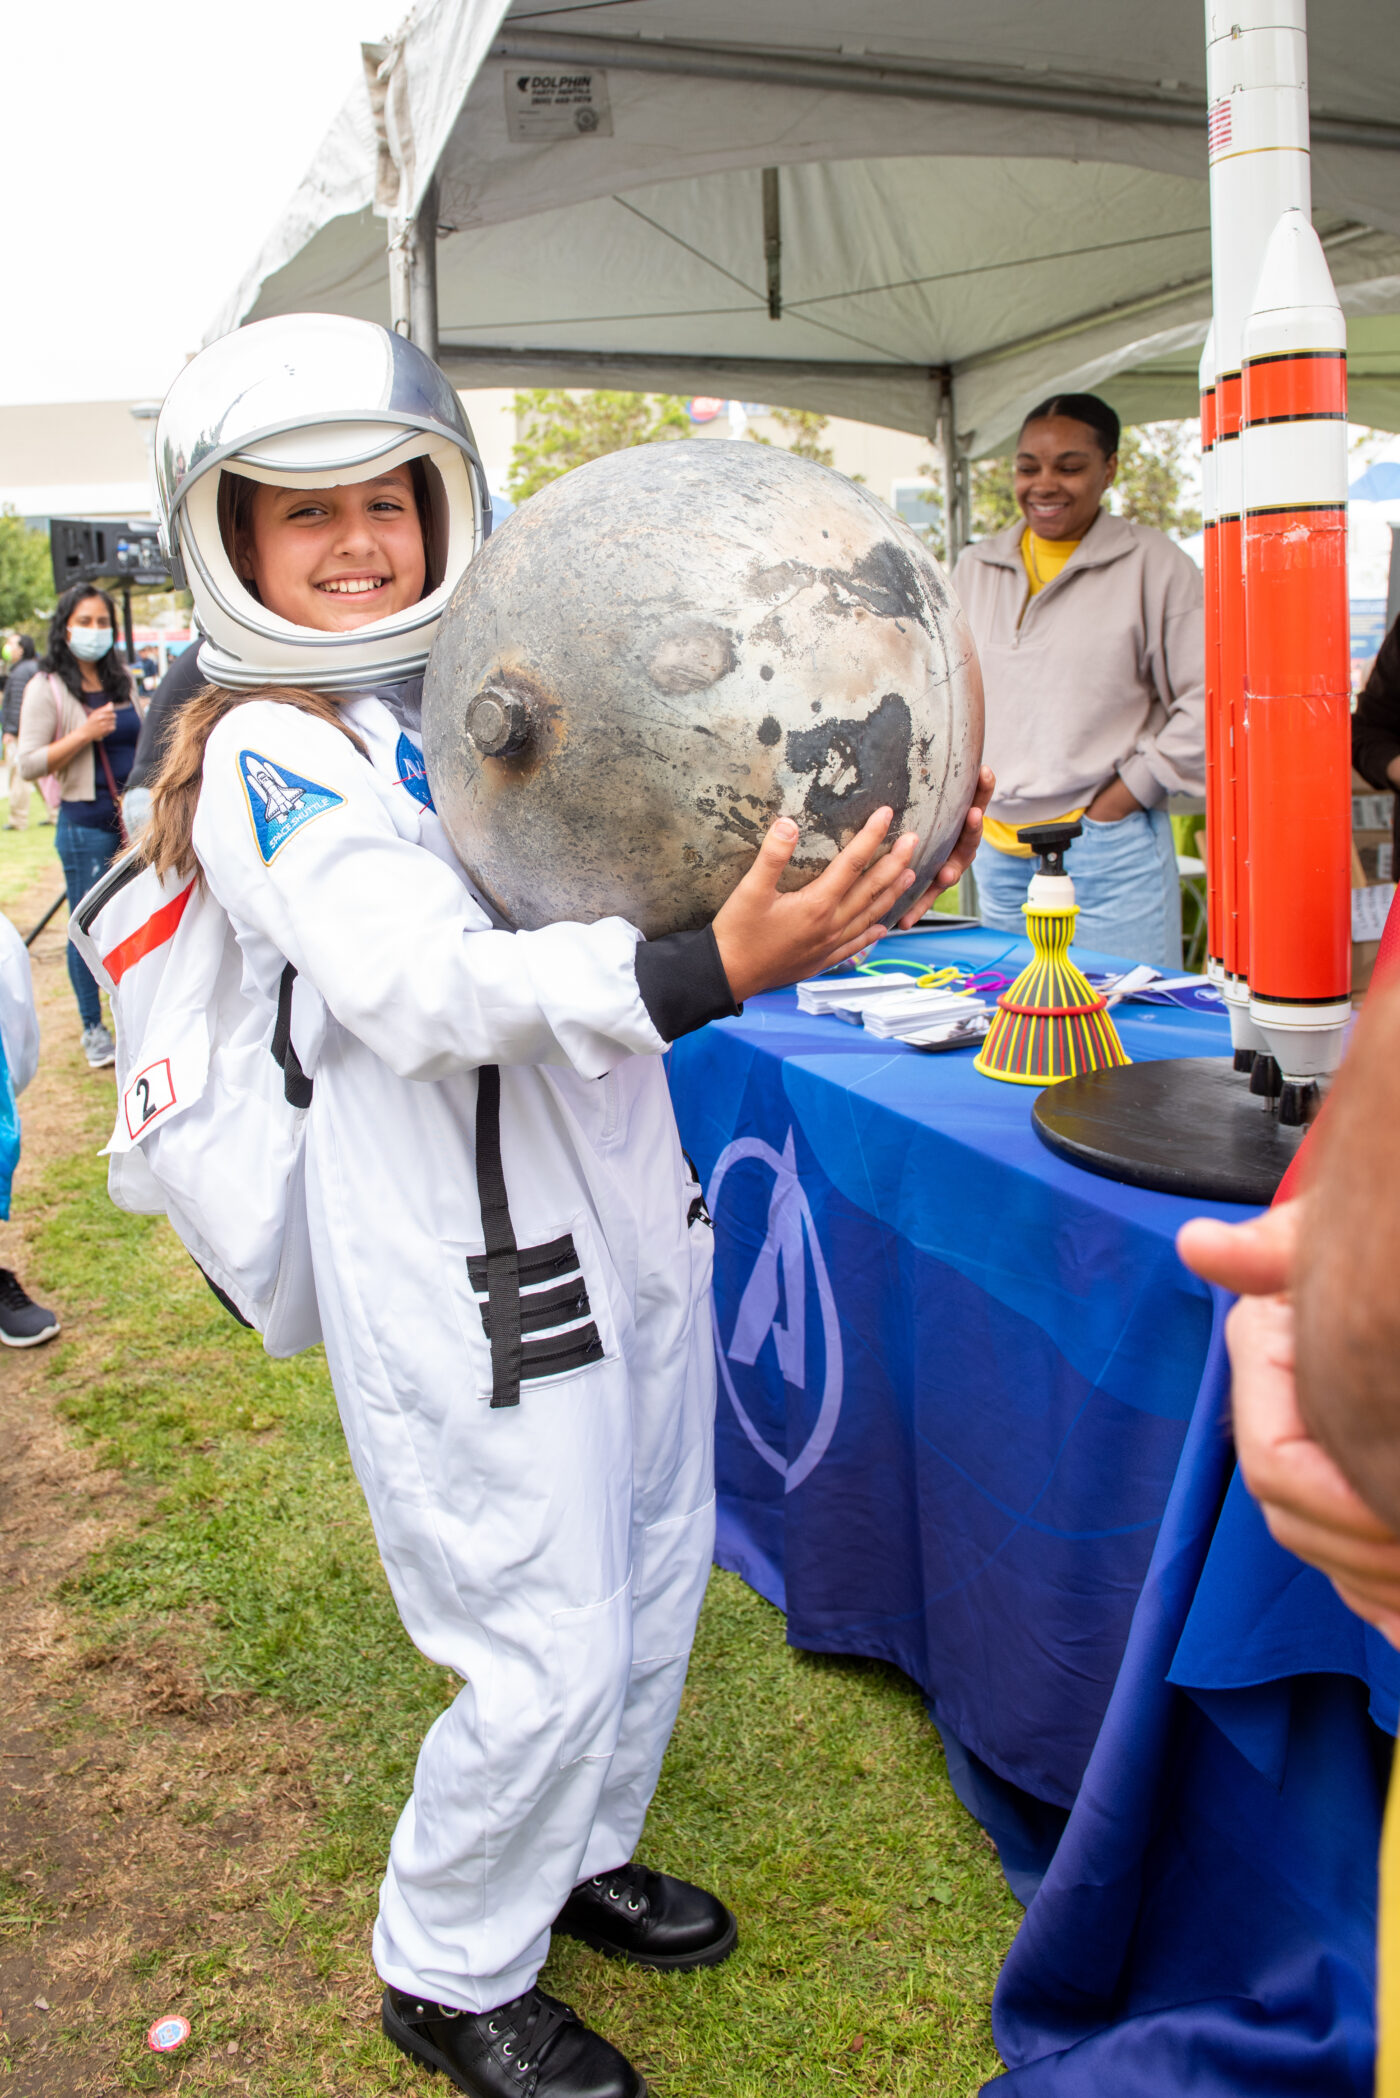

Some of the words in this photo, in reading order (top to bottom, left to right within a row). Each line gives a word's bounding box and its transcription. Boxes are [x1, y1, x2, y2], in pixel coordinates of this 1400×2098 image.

[531, 76, 592, 88] DOLPHIN
[269, 822, 293, 849] SPACE
[291, 798, 330, 827] SHUTTLE
[136, 1078, 157, 1122] 2
